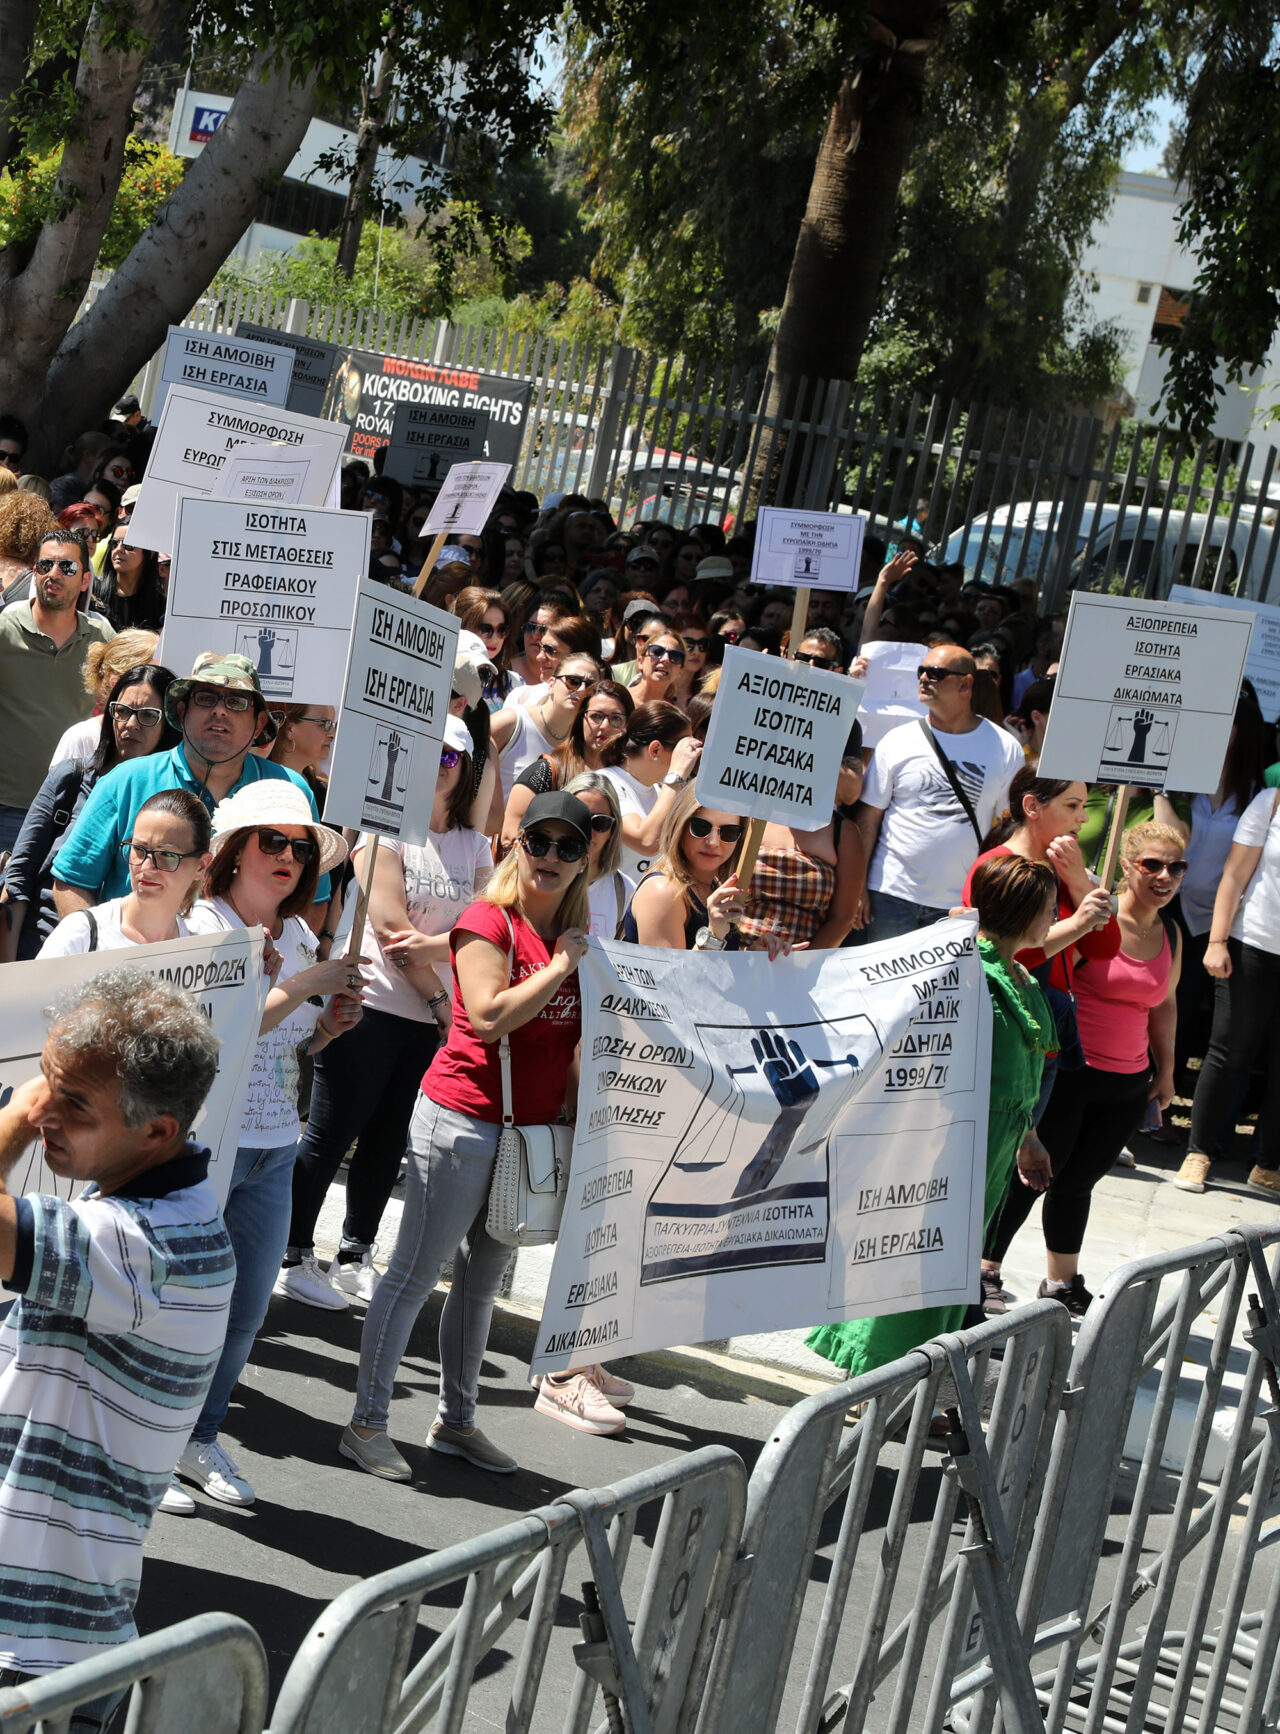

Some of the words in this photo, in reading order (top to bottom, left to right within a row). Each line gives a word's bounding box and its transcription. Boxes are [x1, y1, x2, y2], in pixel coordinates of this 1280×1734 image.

[186, 340, 209, 355] ΙΣΗ
[213, 346, 275, 370] ΑΜΟΙΒΗ
[183, 364, 206, 380] ΙΣΗ
[211, 370, 268, 394] ΕΡΓΑΣΙΑ
[293, 371, 326, 385] ΧΟΛΗΣΗΣ
[382, 356, 438, 382] ΜΟΛΩΝ
[438, 368, 480, 390] ΛΑΒΕ
[362, 373, 460, 408] KICKBOXING
[463, 393, 523, 425] FIGHTS
[208, 412, 304, 444] ΣΥΜΜΟΡΦΩΣΗ
[409, 410, 428, 422] ΙΣΗ
[430, 412, 477, 428] ΑΜΟΙΒΗ
[351, 443, 364, 456] For
[353, 432, 382, 448] DOORS
[407, 431, 424, 442] ΙΣΗ
[428, 433, 470, 448] ΕΡΓΑΣΙΑ
[183, 448, 226, 468] ΕΥΡΩΠ
[246, 512, 306, 532] ΙΣΟΤΗΤΑ
[212, 540, 242, 556] ΣΤΙΣ
[245, 544, 334, 566] ΜΕΤΑΘΕΣΕΙΣ
[224, 572, 316, 594] ΓΡΑΦΕΙΑΚΟΥ
[220, 600, 316, 622] ΠΡΟΣΩΠΙΚΟΥ
[1126, 616, 1198, 635] ΑΞΙΟΠΡΕΠΕΙΑ
[371, 607, 393, 642] ΙΣΗ
[394, 618, 446, 662] ΑΜΟΙΒΗ
[1135, 642, 1181, 658] ΙΣΟΤΗΤΑ
[1124, 664, 1182, 681] ΕΡΓΑΣΙΑΚΑ
[365, 666, 388, 702] ΙΣΗ
[389, 674, 434, 718] ΕΡΓΑΣΙΑ
[737, 672, 842, 716] ΑΞΙΟΠΡΕΠΕΙΑ
[1113, 688, 1182, 705] ΔΙΚΑΙΩΜΑΤΑ
[754, 707, 814, 740] ΙΣΟΤΙΤΑ
[735, 736, 814, 772] ΕΡΓΑΣΑΚΑ
[720, 766, 812, 806] ΔΙΚΑΙΩΜΑΤΑ
[639, 1044, 686, 1064] ΟΡΩΝ
[581, 1169, 633, 1206] ΑΞΙΟΠΡΕΠΕΙΑ
[858, 1187, 882, 1211] ΙΣΗ
[884, 1176, 948, 1206] ΑΜΟΙΒΗ
[654, 1222, 715, 1237] ΠΑΓΚΥΠΡΙΑ
[762, 1204, 814, 1222] ΙΣΟΤΗΤΑ
[764, 1227, 824, 1242] ΔΙΚΑΙΩΜΑΤΑ
[584, 1222, 618, 1254] ΙΣΟΤΗΤΑ
[853, 1239, 876, 1260] ΙΣΗ
[880, 1226, 944, 1258] ΕΡΓΑΣΙΑ
[566, 1270, 618, 1304] ΕΡΓΑΣΙΑΚΑ
[544, 1319, 619, 1354] ΔΙΚΑΙΩΜΑΤΑ
